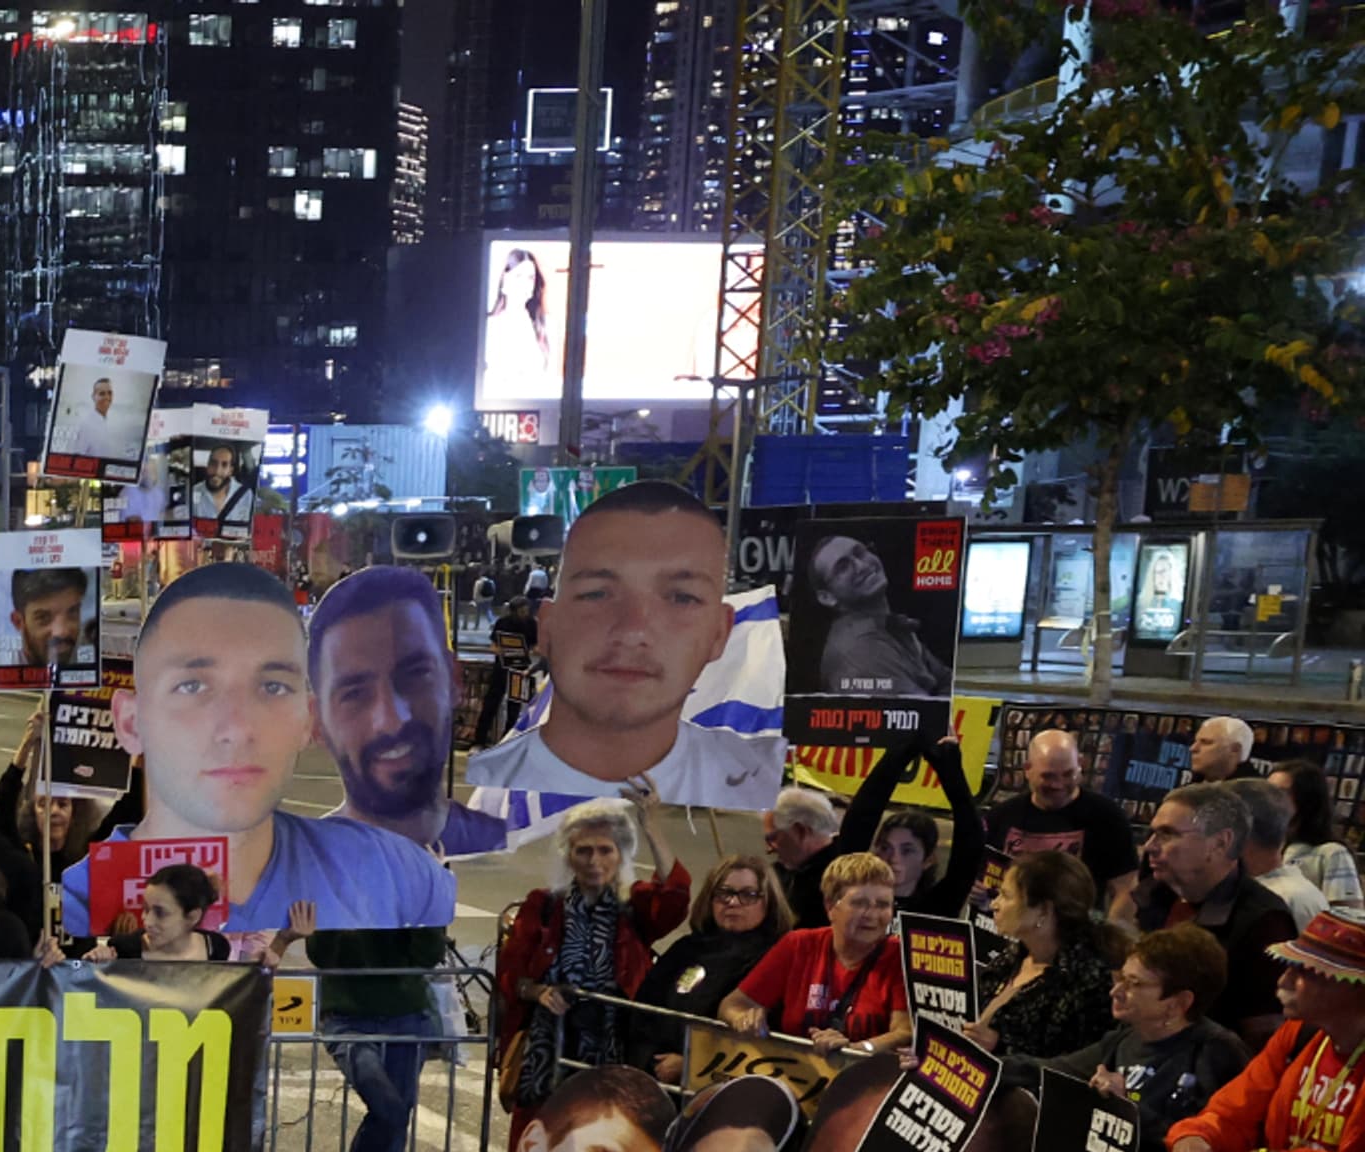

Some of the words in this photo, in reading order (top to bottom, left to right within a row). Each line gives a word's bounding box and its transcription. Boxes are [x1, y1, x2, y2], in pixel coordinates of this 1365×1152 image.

[916, 549, 956, 574] all
[916, 576, 953, 587] HOME
[55, 704, 115, 728] סרבים
[883, 709, 921, 731] תמיר
[913, 982, 967, 1014] מסרבים
[897, 1082, 966, 1144] מסרבים
[1090, 1108, 1134, 1146] קודם
